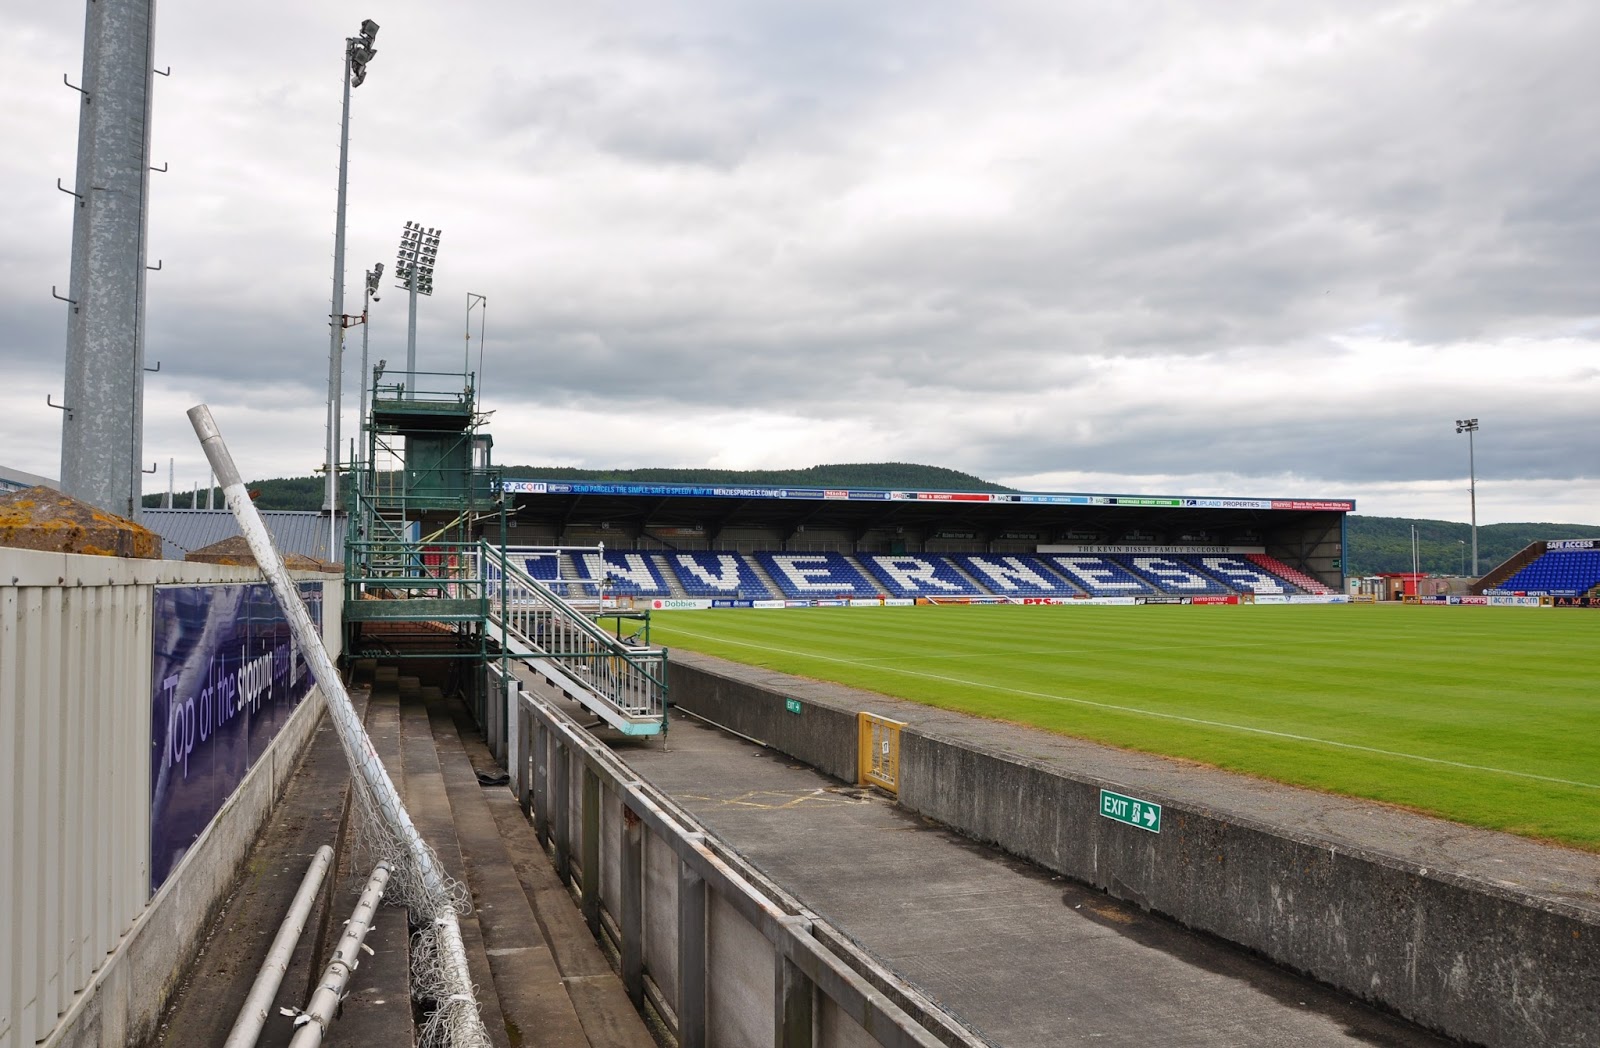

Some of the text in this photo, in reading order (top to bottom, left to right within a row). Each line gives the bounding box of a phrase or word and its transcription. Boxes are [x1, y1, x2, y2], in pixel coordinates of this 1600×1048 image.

[515, 482, 544, 492] acorn
[164, 674, 195, 778] Top
[200, 656, 214, 742] of
[218, 654, 235, 726] the
[238, 639, 272, 714] shopping
[1104, 796, 1128, 817] EXIT
